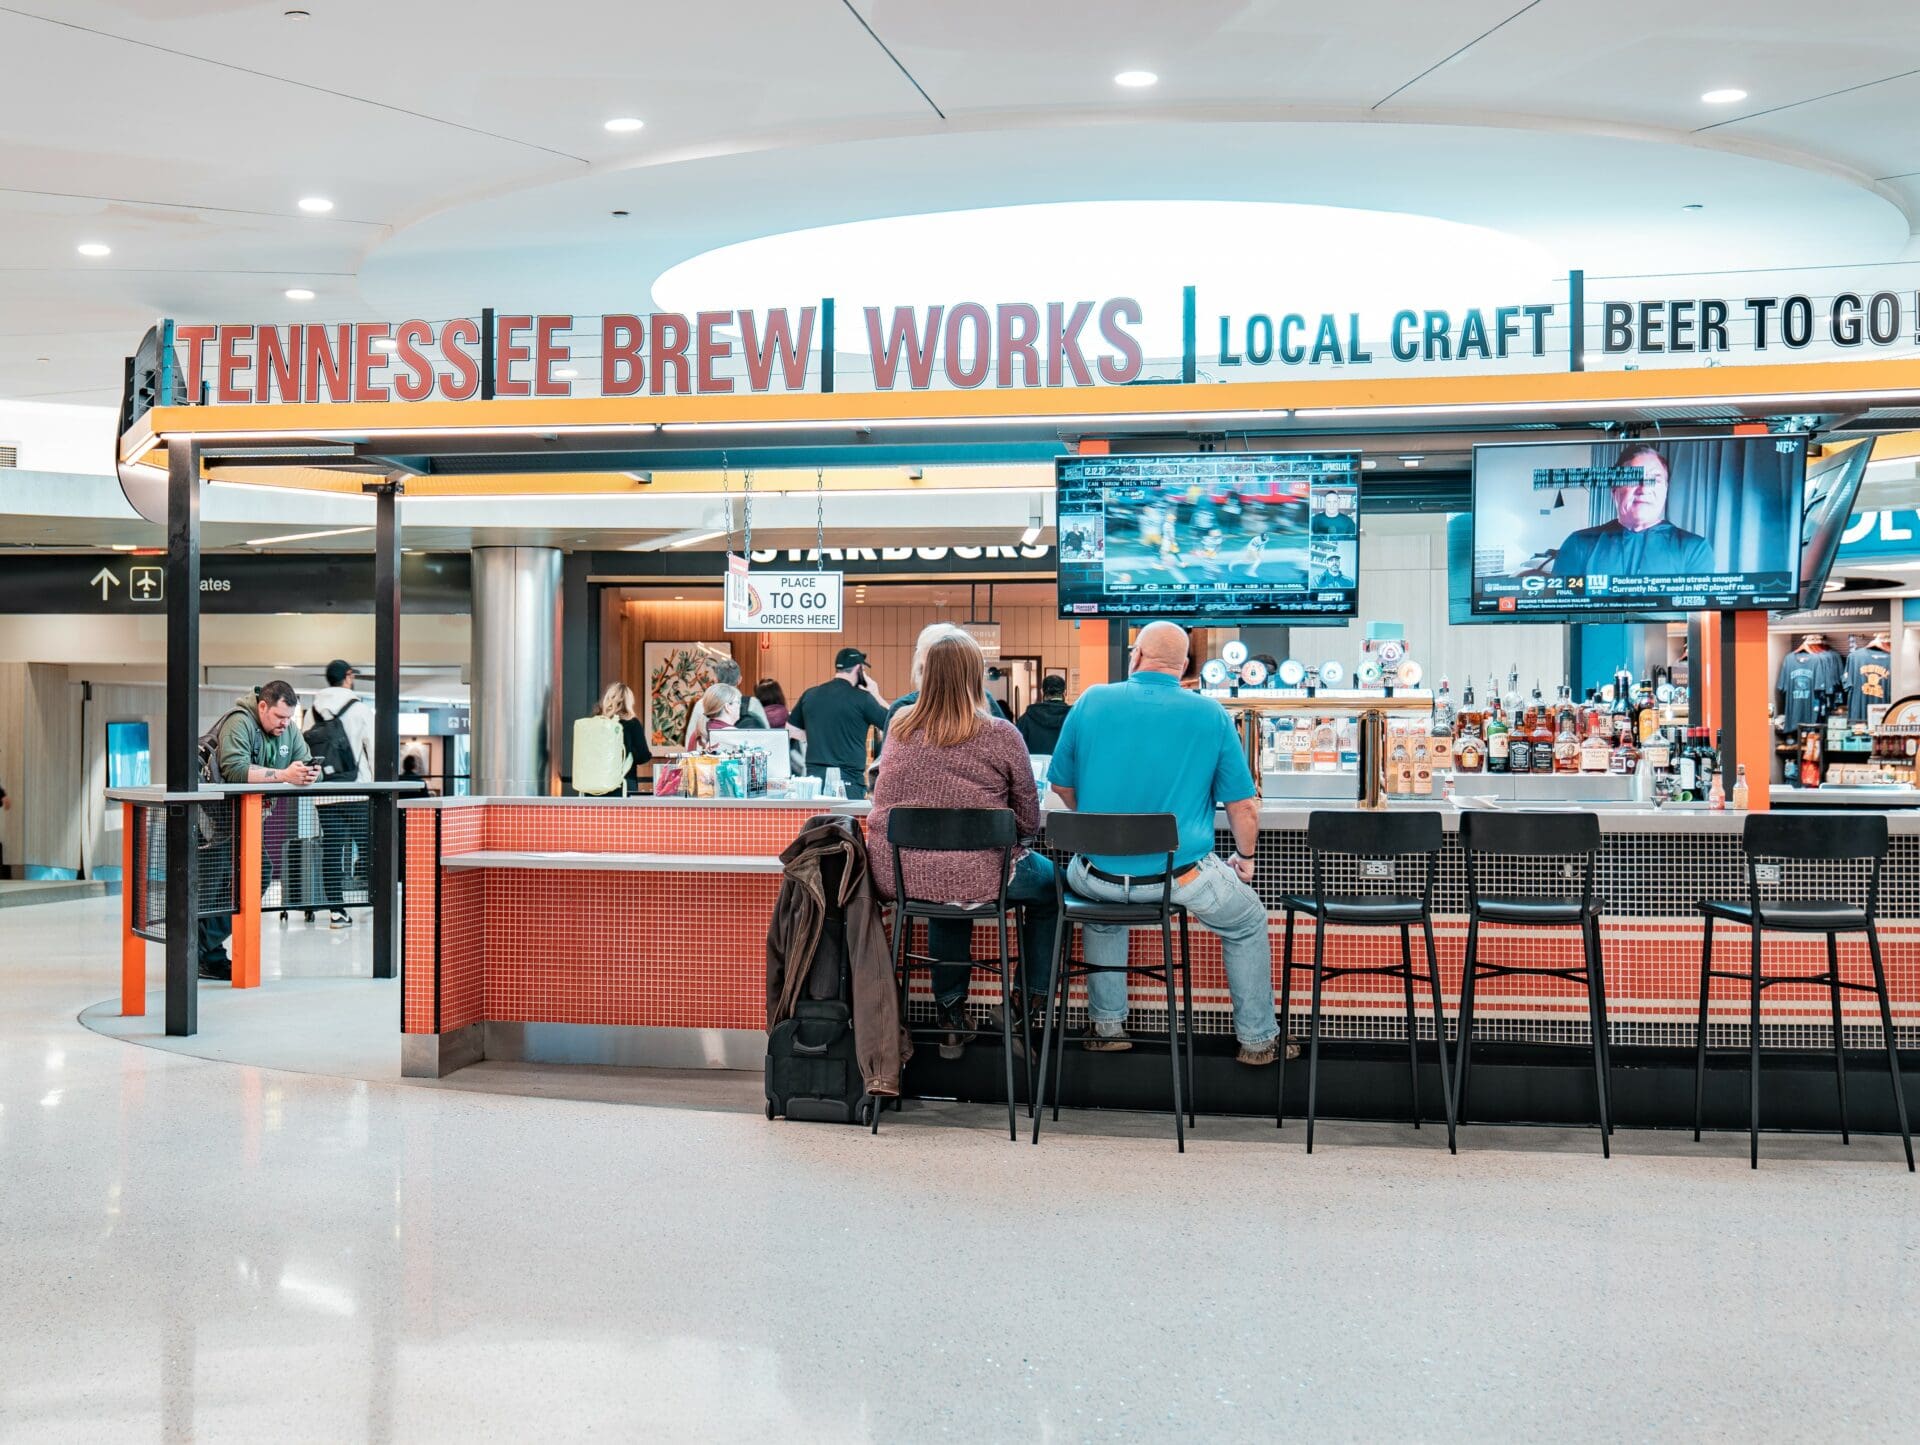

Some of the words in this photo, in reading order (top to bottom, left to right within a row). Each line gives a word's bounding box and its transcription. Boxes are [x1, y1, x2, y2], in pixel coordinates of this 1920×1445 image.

[1218, 312, 1372, 366] LOCAL
[1391, 304, 1554, 361] CRAFT
[1602, 299, 1730, 354] BEER
[1745, 294, 1814, 350] TO
[176, 314, 573, 404] TENNESSEE
[601, 306, 817, 397] BREW
[863, 297, 1142, 391] WORKS
[200, 577, 231, 591] ates
[781, 577, 816, 588] PLACE
[1547, 578, 1563, 588] 22
[1568, 577, 1584, 588] 24
[770, 592, 793, 608] TO
[800, 592, 827, 609] GO
[1317, 593, 1344, 601] ESPN
[1813, 608, 1839, 617] SUPPLY
[1839, 606, 1874, 616] COMPANY
[760, 614, 804, 625] ORDERS
[807, 614, 836, 624] HERE
